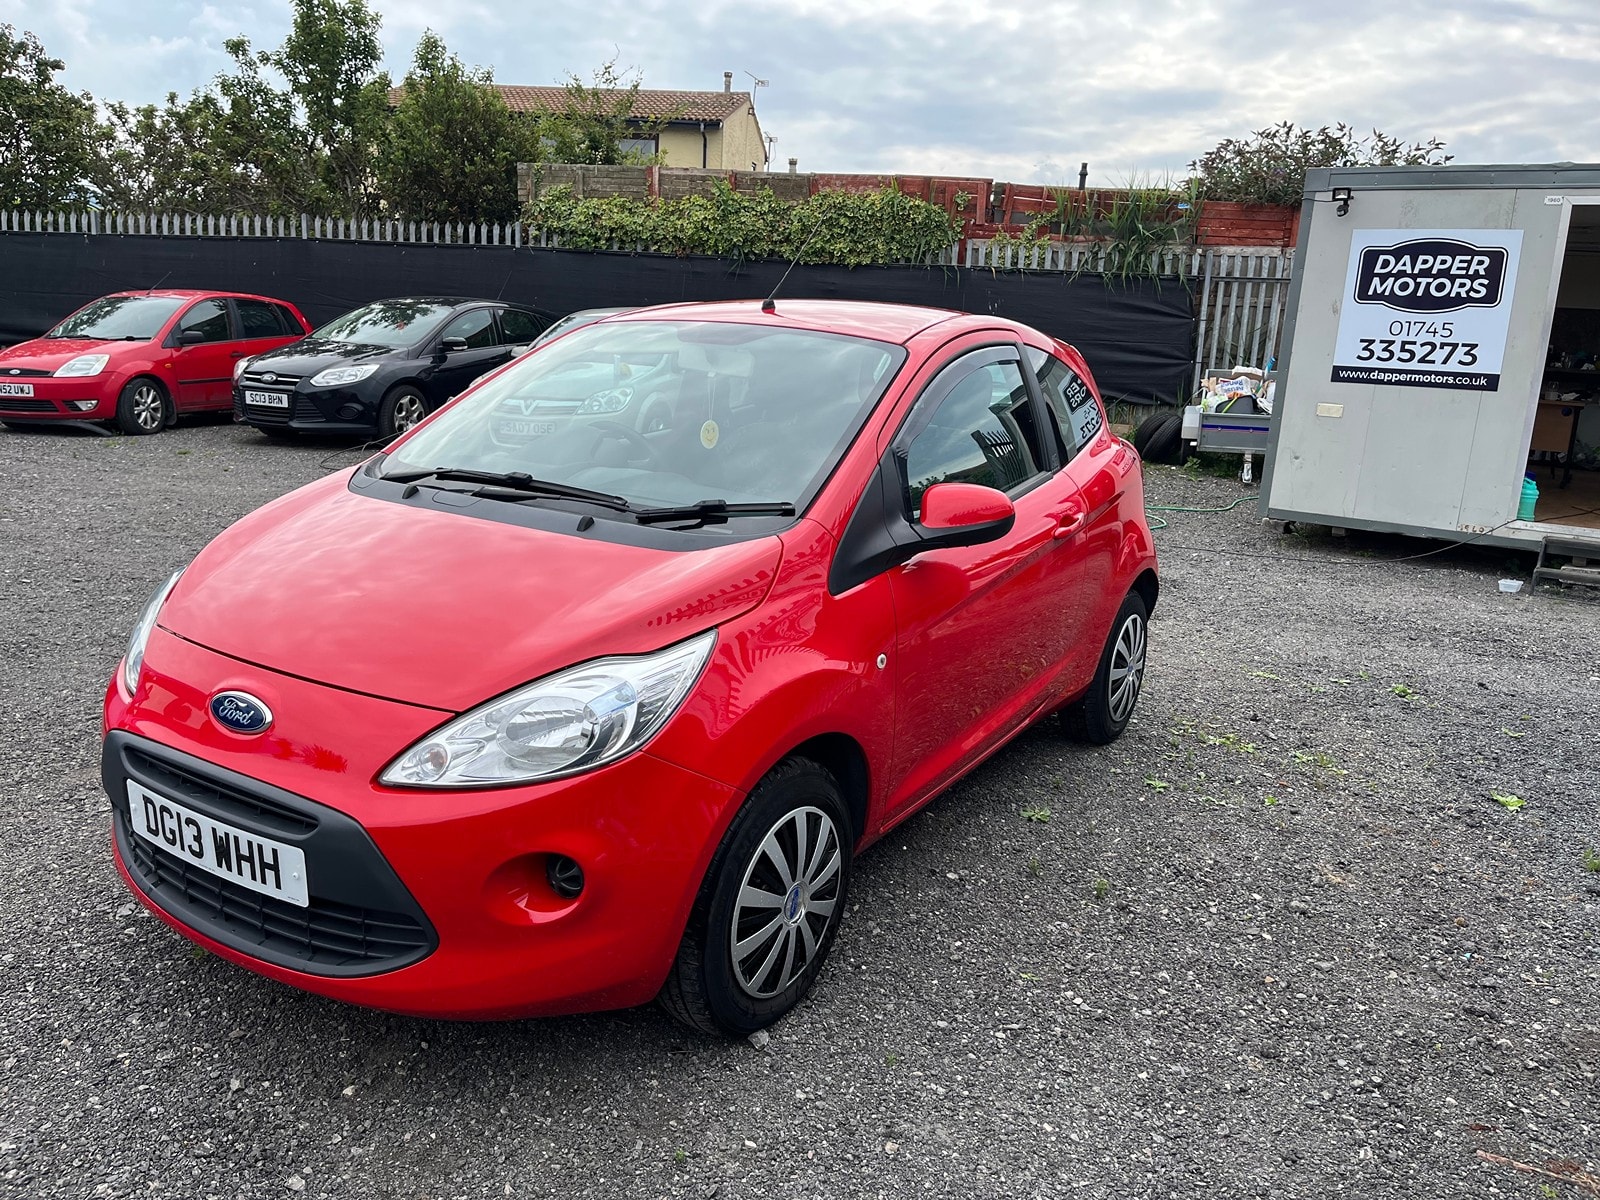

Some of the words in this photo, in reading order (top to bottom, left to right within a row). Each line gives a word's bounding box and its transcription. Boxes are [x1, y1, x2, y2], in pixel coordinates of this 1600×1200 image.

[1374, 254, 1490, 275] DAPPER
[1367, 276, 1490, 298] MOTORS
[1389, 320, 1454, 338] 01745
[1356, 338, 1479, 366] 335273
[1338, 369, 1488, 387] www.dappermotors.co.uk
[14, 385, 30, 395] UWJ
[250, 393, 266, 404] SC13
[218, 697, 253, 726] Ford
[142, 793, 204, 860] DG13
[211, 826, 282, 891] WHH
